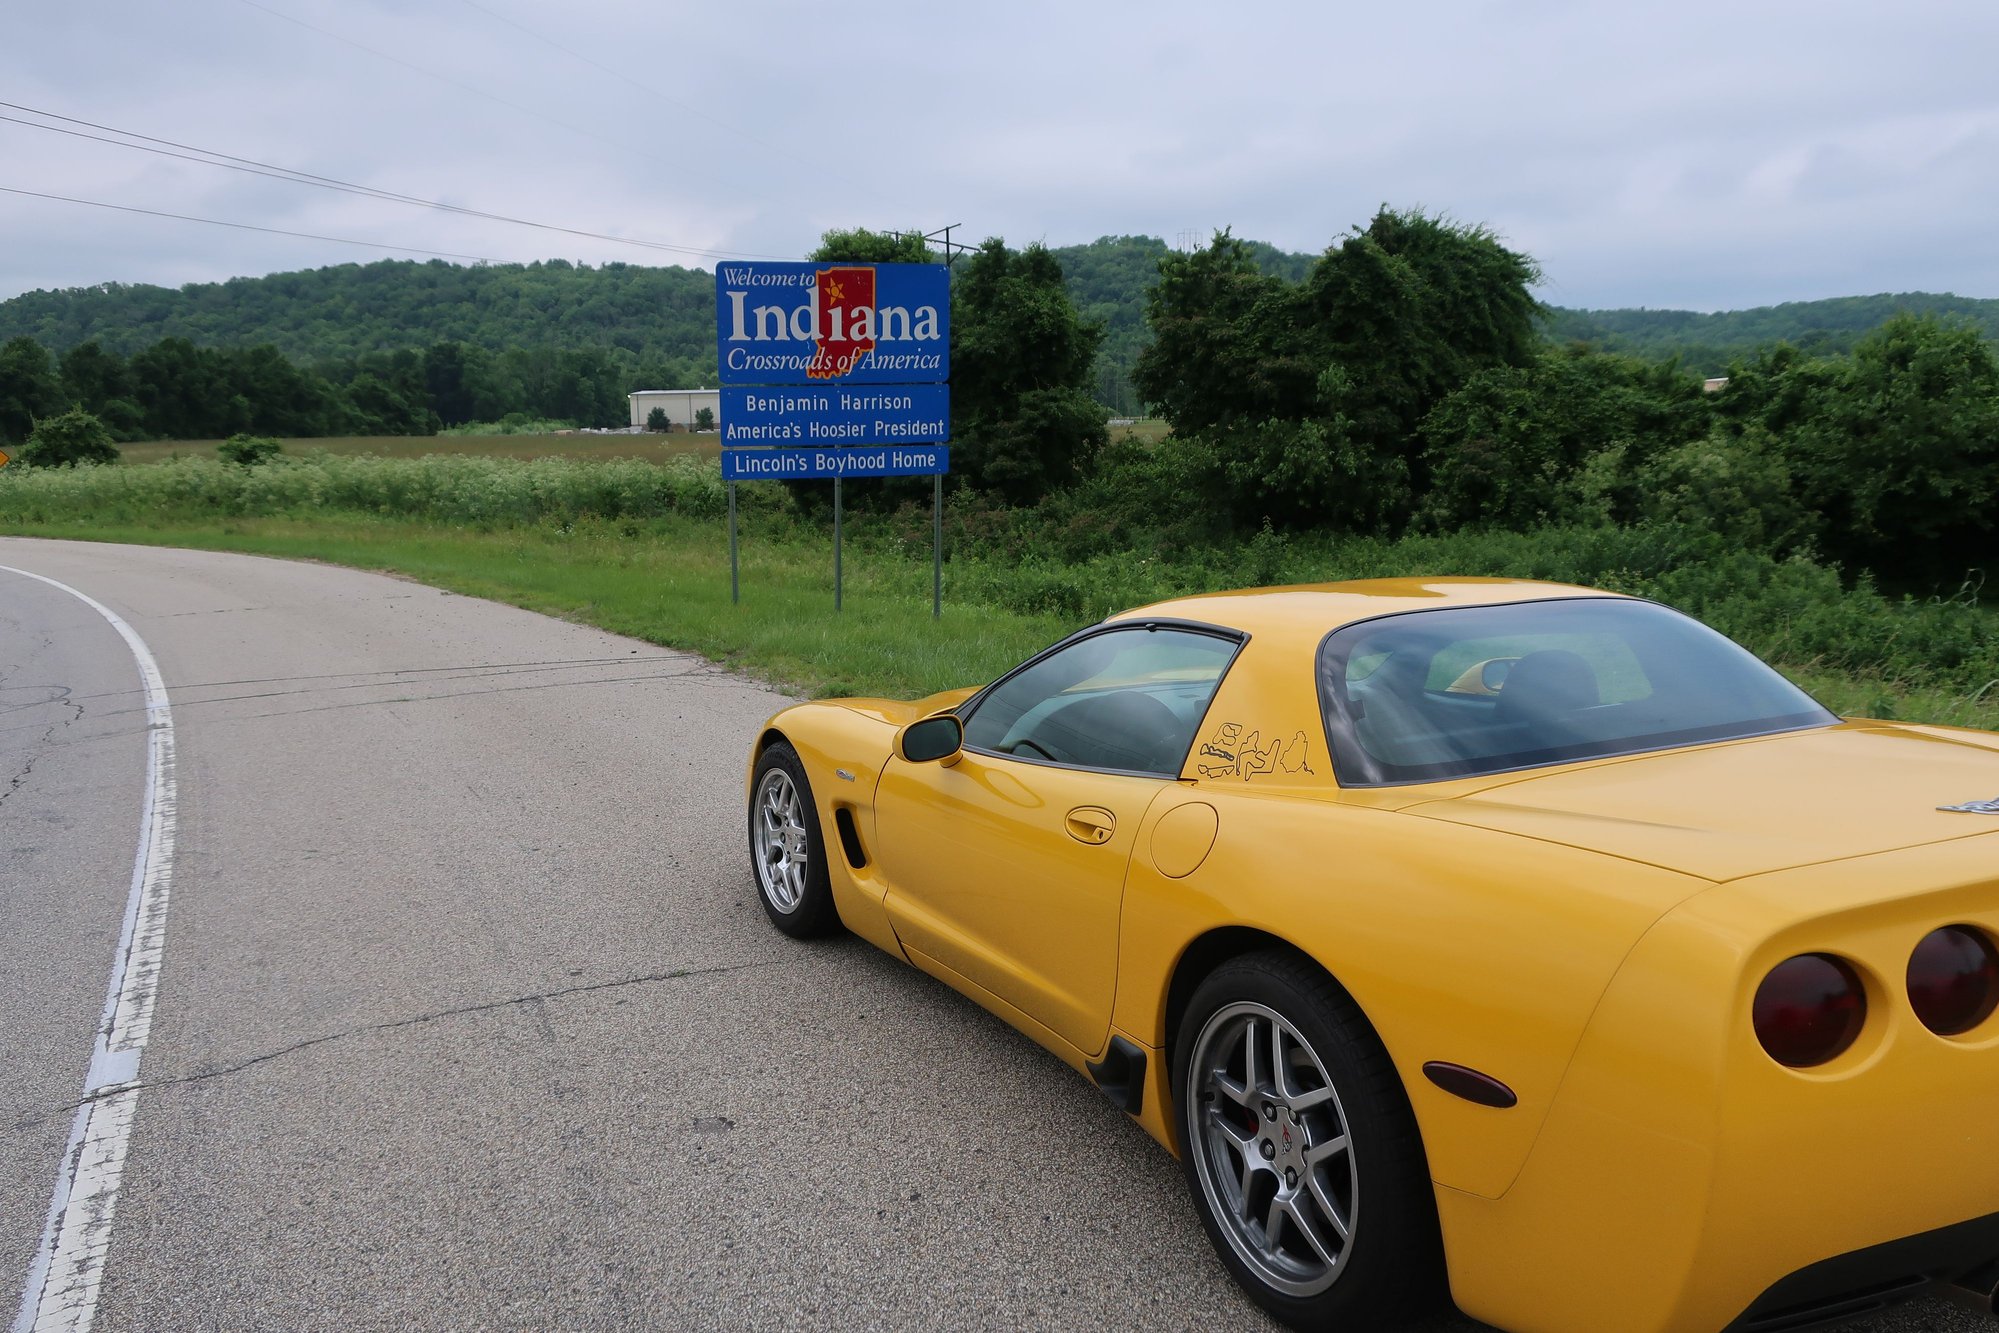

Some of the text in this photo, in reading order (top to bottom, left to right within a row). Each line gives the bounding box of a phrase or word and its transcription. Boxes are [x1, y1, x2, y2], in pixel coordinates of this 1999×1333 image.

[723, 267, 815, 286] Welcome to
[726, 286, 941, 342] Indiana
[727, 347, 941, 376] Crossroads of America
[746, 394, 912, 415] Benjamin Harrison
[726, 419, 944, 439] America's Hoosier President
[735, 452, 936, 473] Lincoln's Boyhood Home
